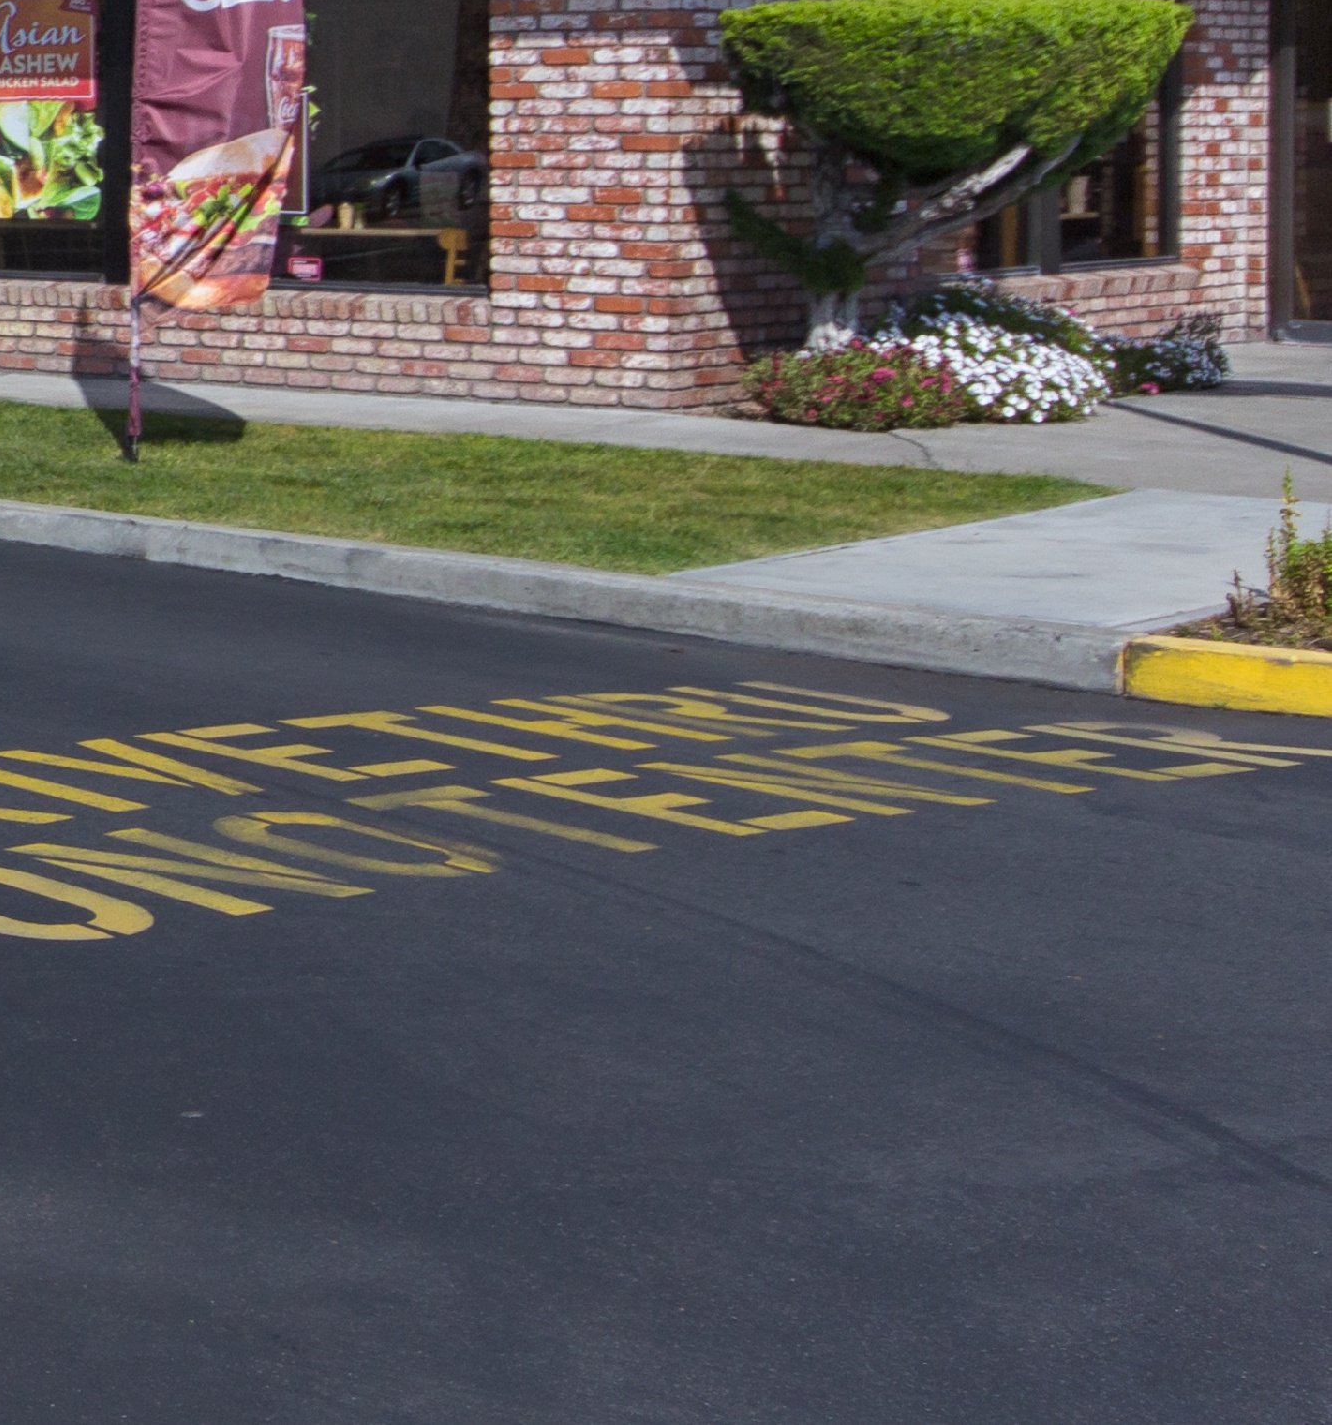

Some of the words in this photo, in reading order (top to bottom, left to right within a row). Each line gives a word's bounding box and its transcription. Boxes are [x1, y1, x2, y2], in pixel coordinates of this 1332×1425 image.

[41, 76, 79, 87] SALAD
[277, 681, 951, 761] THRU
[6, 785, 663, 916] NOT
[491, 720, 1332, 836] ENTER
